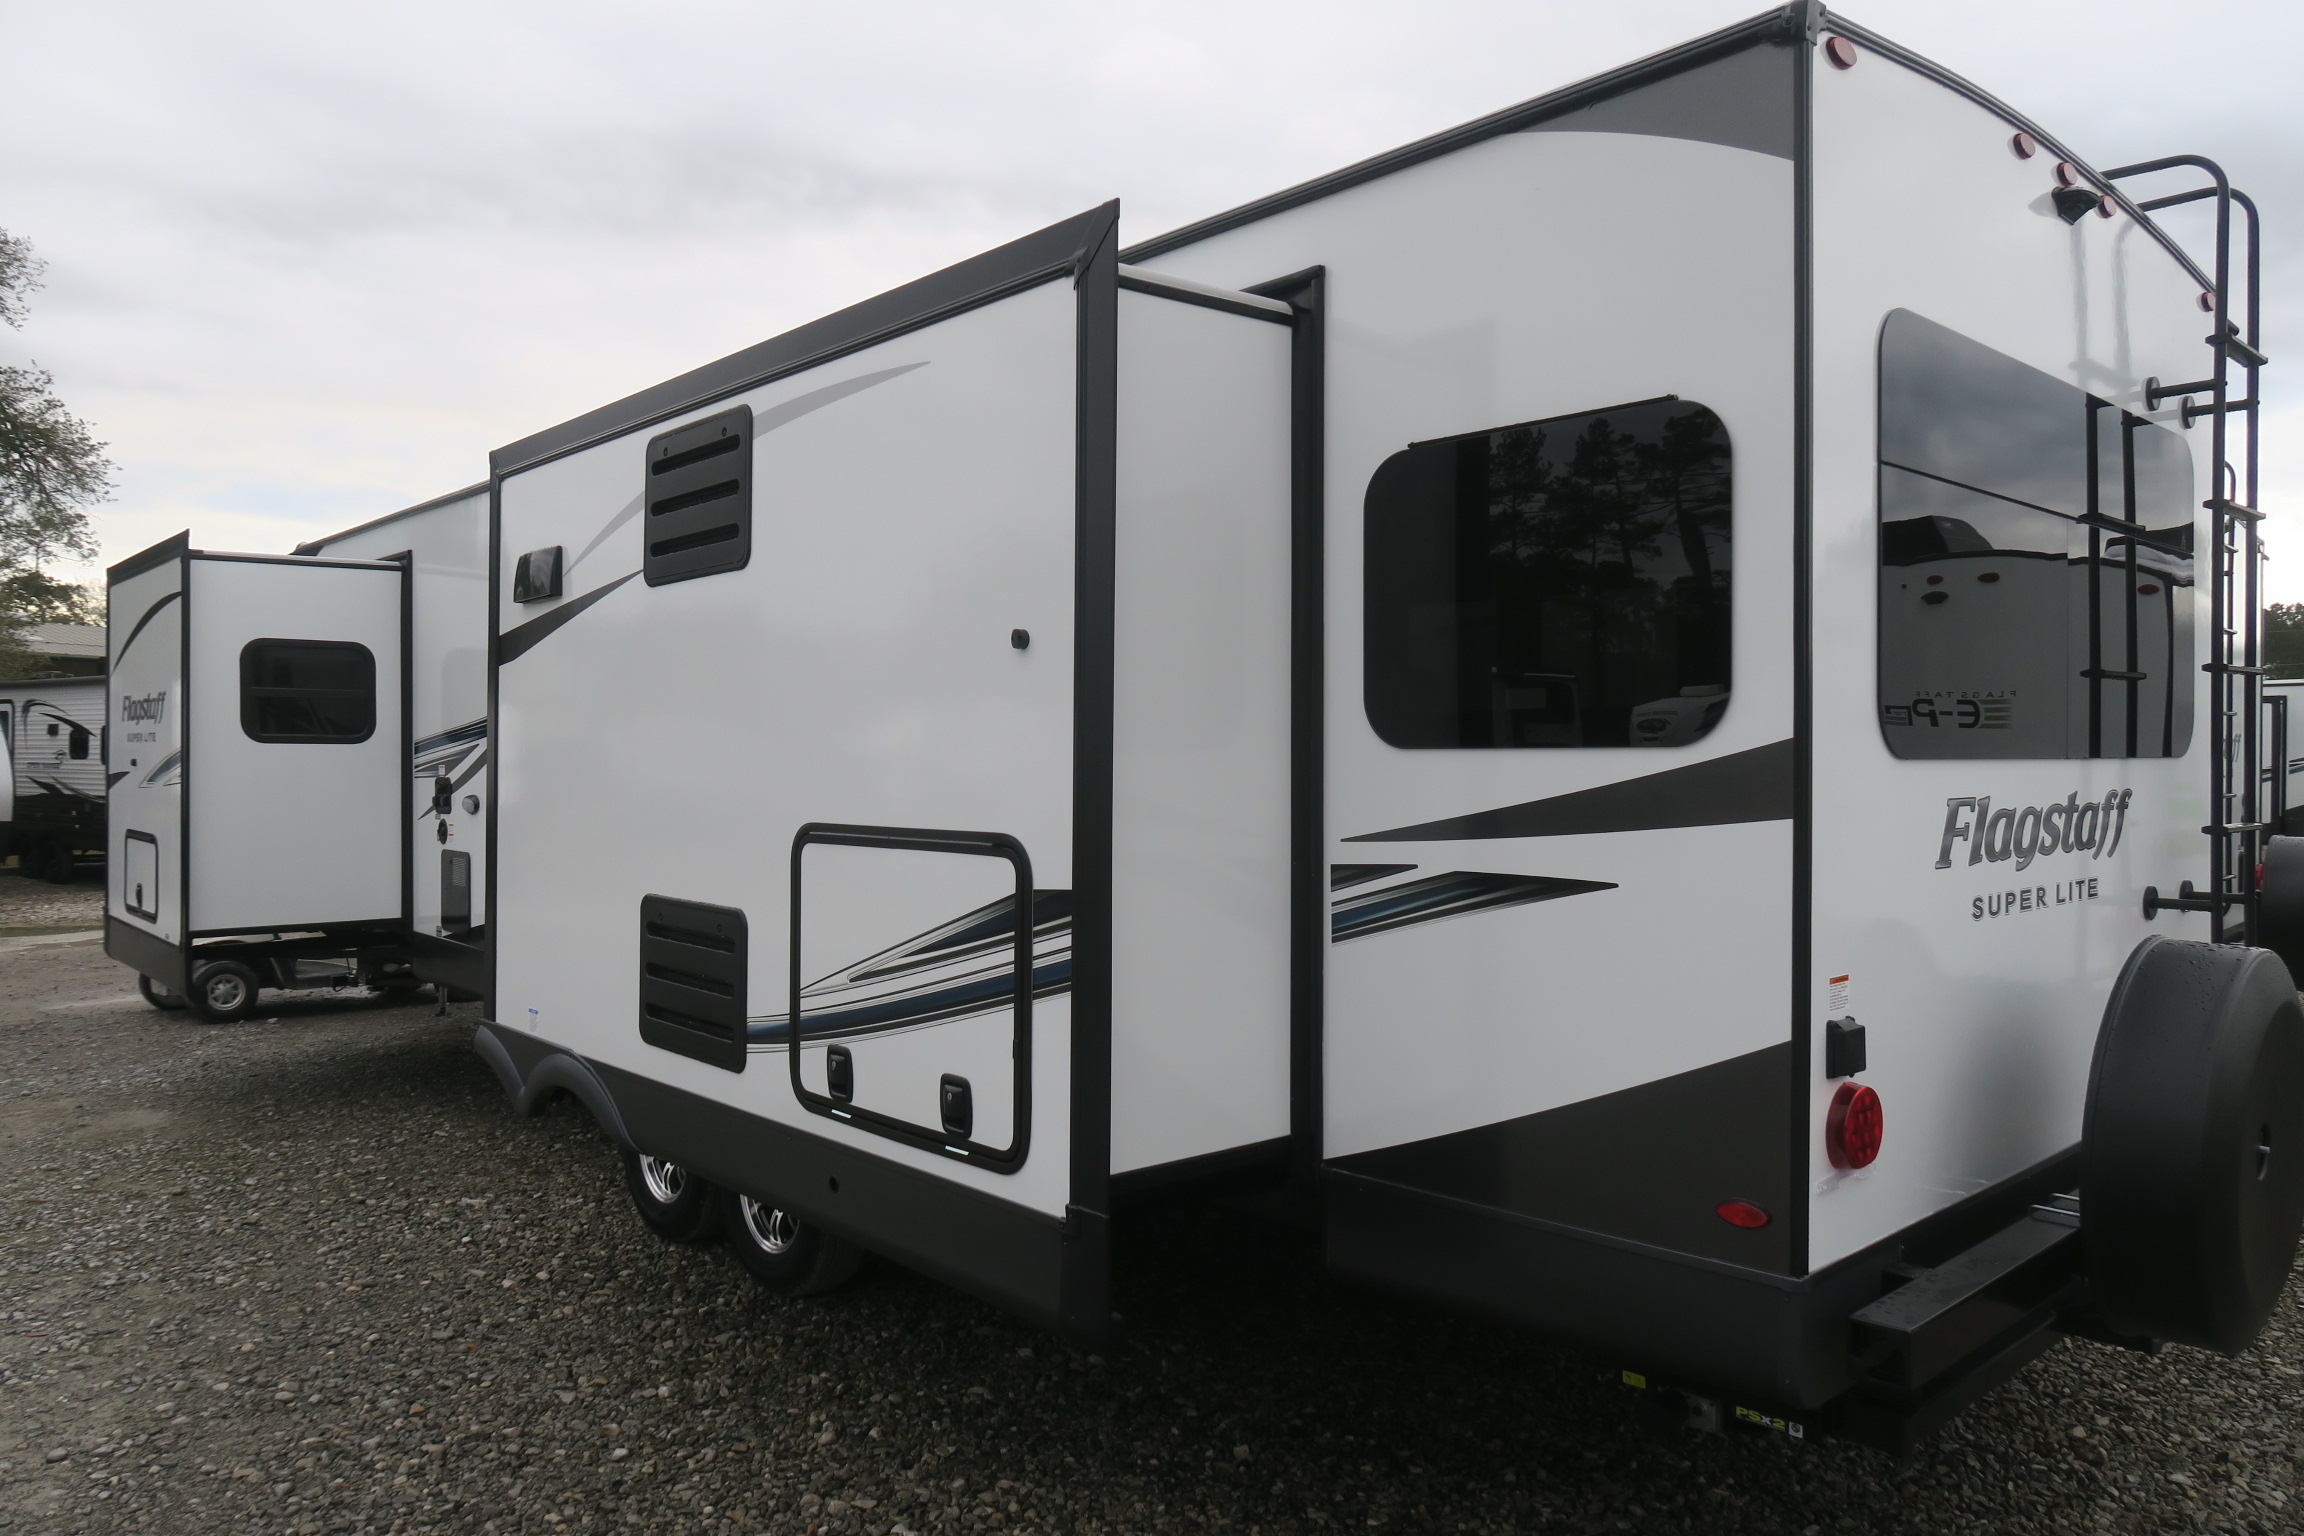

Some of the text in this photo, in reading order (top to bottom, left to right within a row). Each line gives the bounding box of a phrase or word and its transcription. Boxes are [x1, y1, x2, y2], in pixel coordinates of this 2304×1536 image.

[122, 691, 166, 726] Flagstaff
[1934, 788, 2133, 872] Flagstaff
[1971, 876, 2099, 922] SUPER LITE
